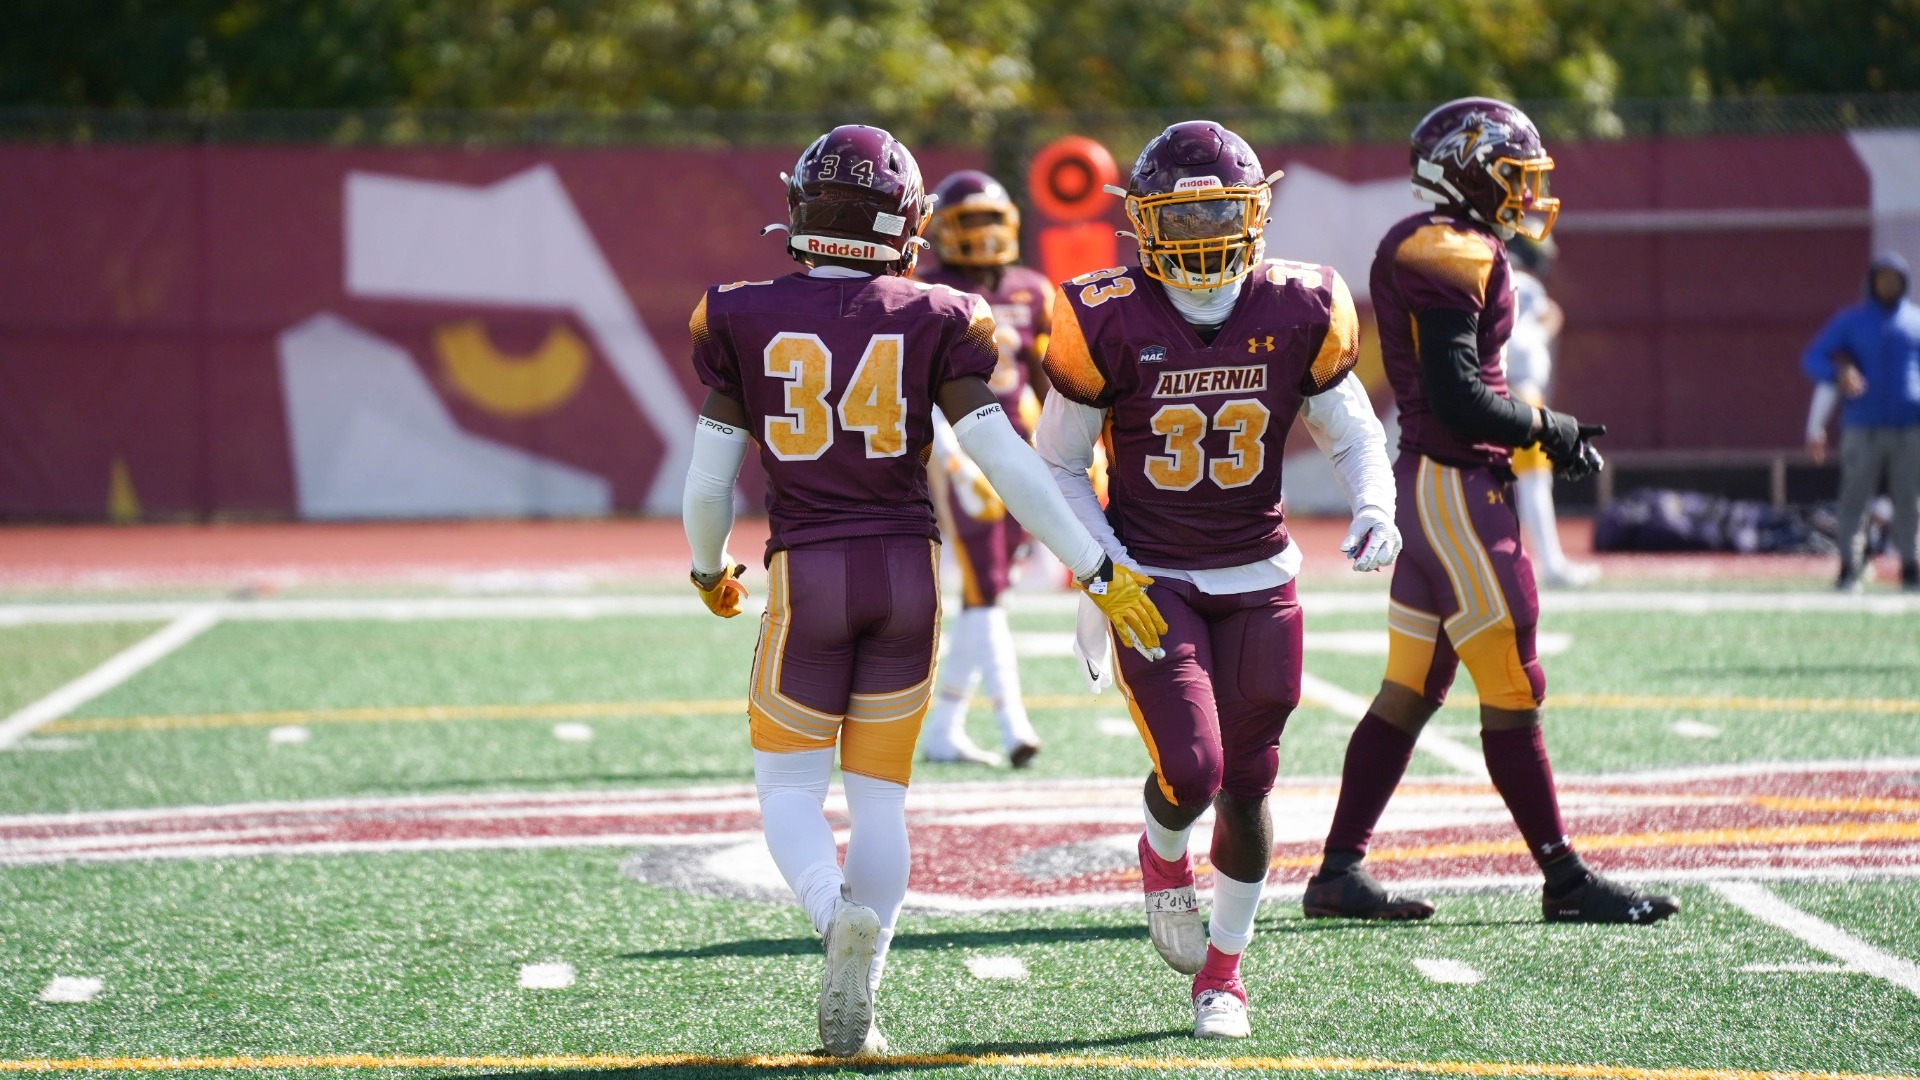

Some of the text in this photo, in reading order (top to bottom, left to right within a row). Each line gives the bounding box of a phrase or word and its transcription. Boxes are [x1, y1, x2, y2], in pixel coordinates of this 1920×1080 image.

[808, 239, 875, 259] Riddell
[1140, 353, 1163, 361] MAC
[1156, 367, 1265, 396] ALVERNIA
[764, 331, 907, 461] 34
[976, 405, 1001, 420] NIKE
[705, 420, 734, 435] PRO
[1144, 398, 1271, 491] 33
